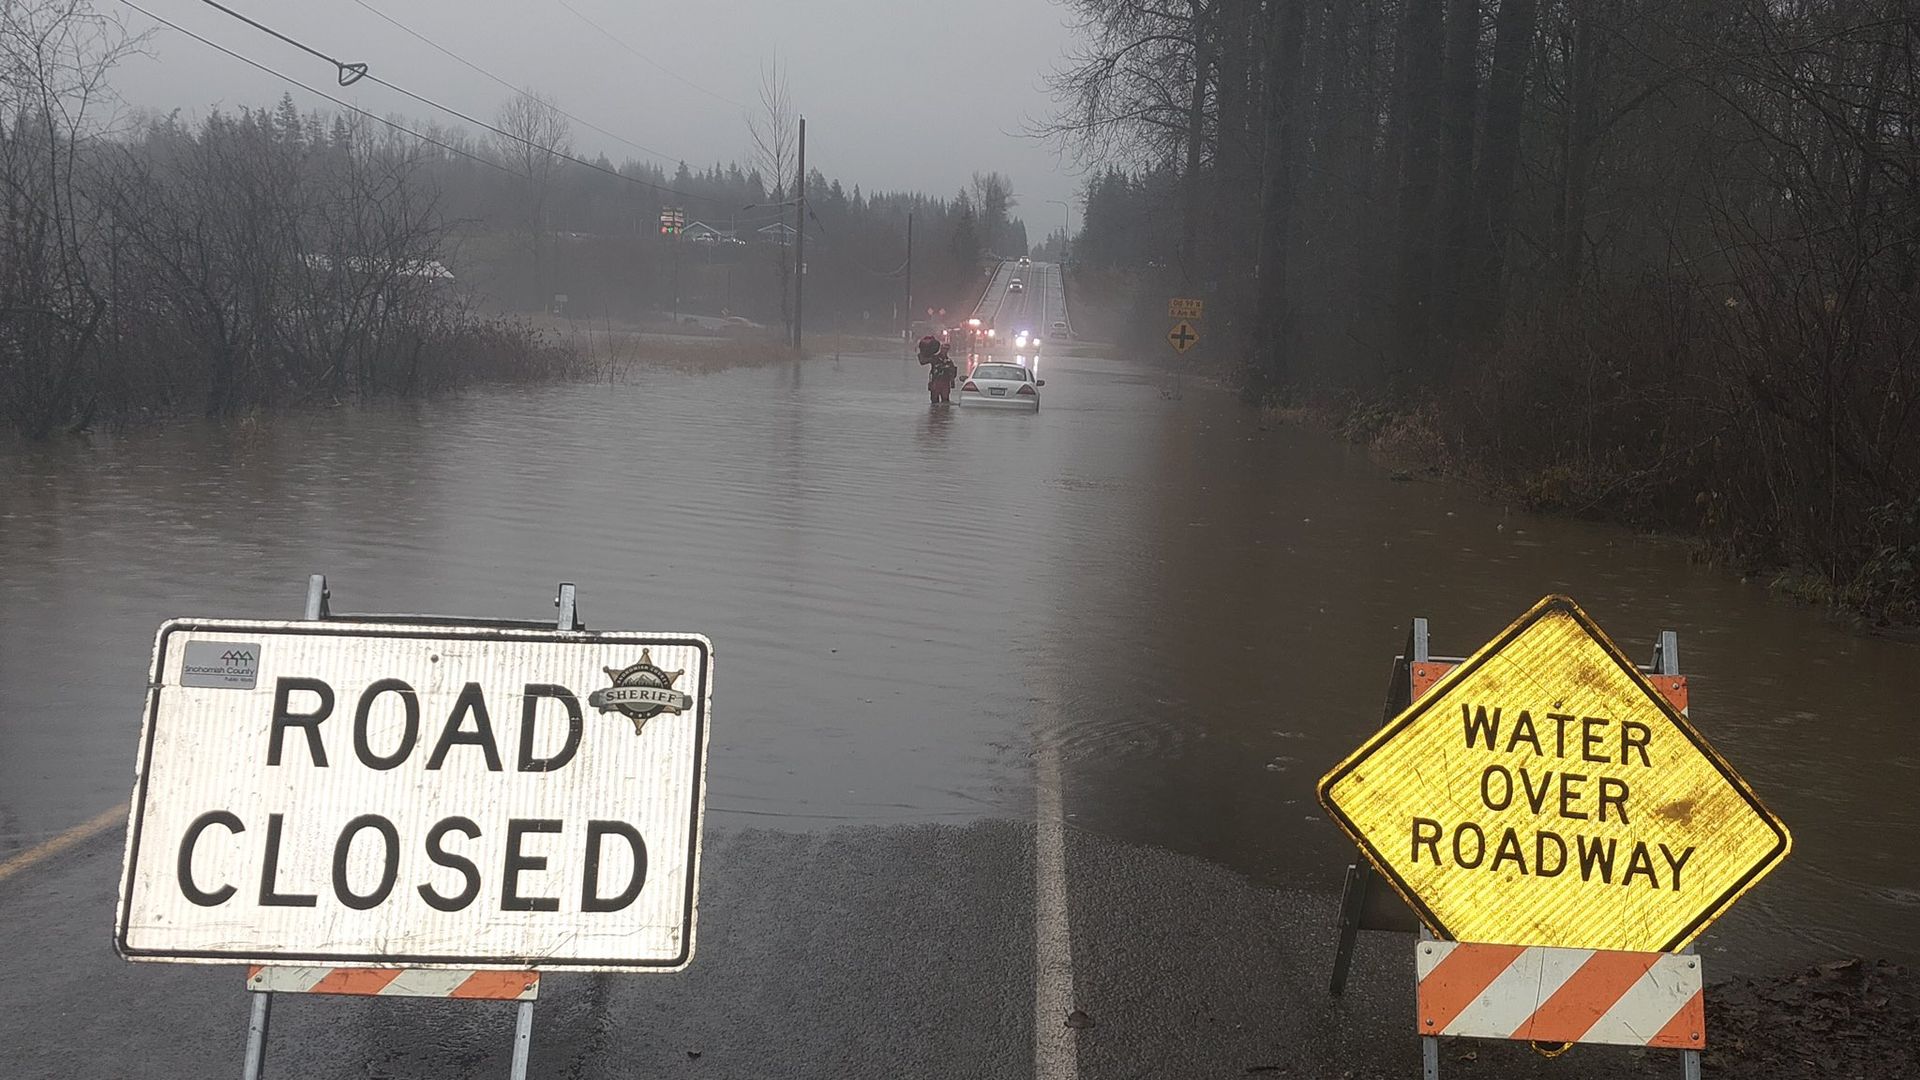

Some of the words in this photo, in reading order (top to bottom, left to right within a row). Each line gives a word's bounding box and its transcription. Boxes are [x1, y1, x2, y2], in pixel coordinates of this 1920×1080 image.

[226, 667, 255, 676] County
[606, 689, 677, 703] SHERIFF
[266, 677, 584, 773] ROAD
[1461, 703, 1652, 768] WATER
[1481, 765, 1630, 825] OVER
[177, 811, 648, 913] CLOSED
[1411, 817, 1696, 892] ROADWAY
